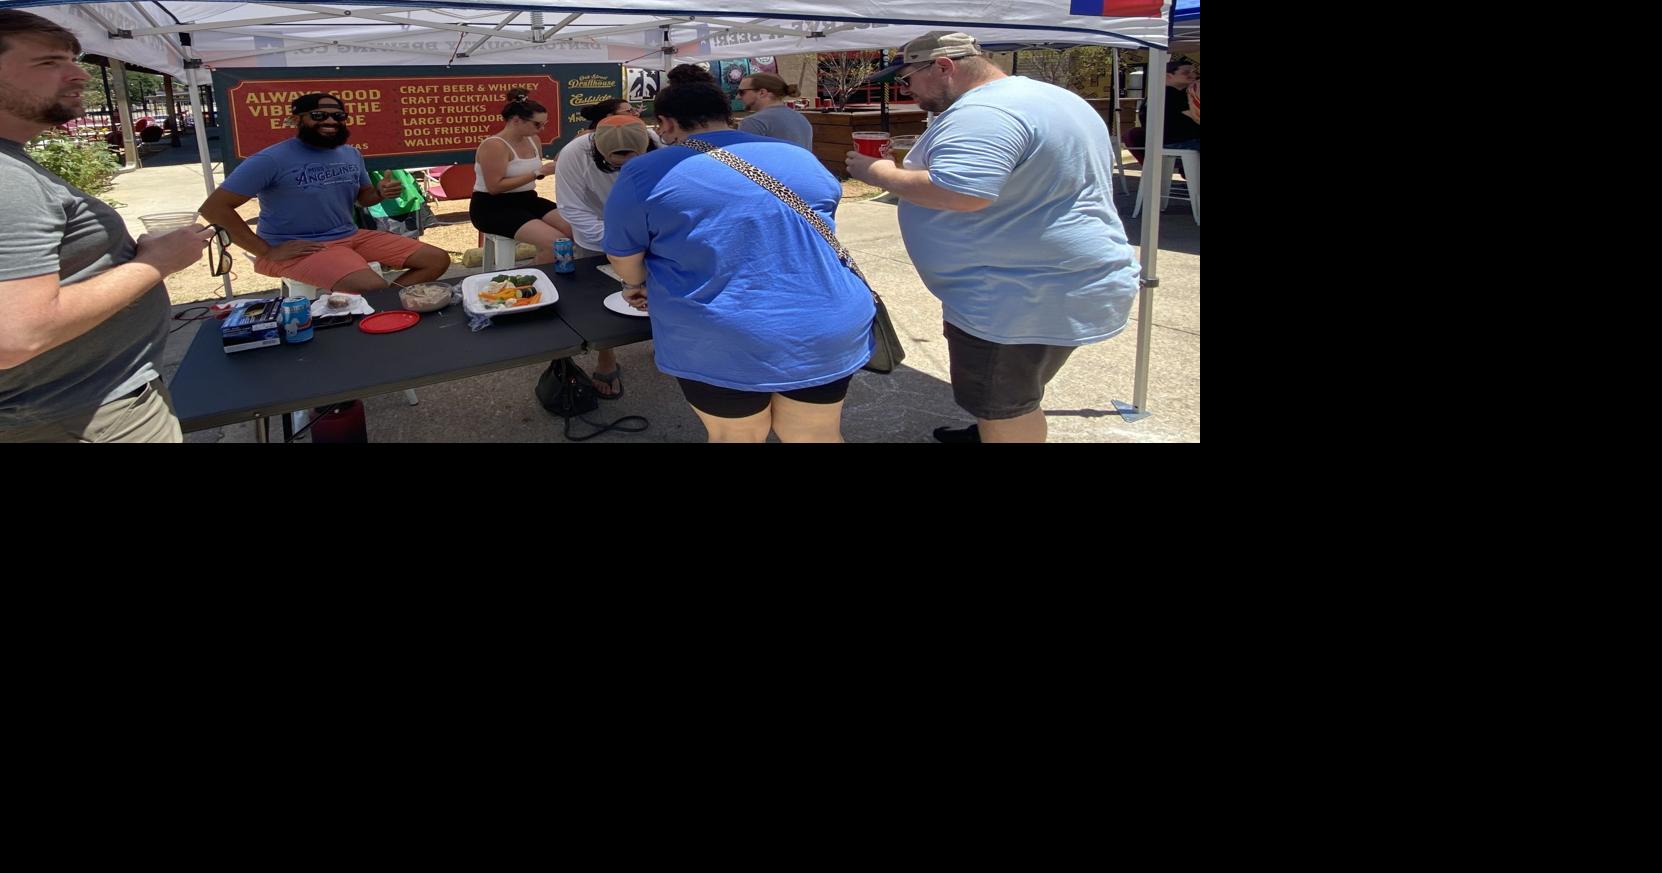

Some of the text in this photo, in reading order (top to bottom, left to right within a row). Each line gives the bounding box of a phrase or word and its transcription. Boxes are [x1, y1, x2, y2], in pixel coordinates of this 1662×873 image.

[400, 85, 439, 94] CRAFT
[443, 84, 474, 93] BEER
[477, 84, 487, 92] &
[401, 94, 506, 105] CRAFT COCKTAILS
[248, 101, 381, 117] VIBE THE
[402, 104, 487, 116] FOOD TRUCKS
[403, 114, 504, 126] LARGE OUTDOOR
[404, 124, 490, 137] DOG FRIENDLY
[404, 136, 461, 147] WALKING
